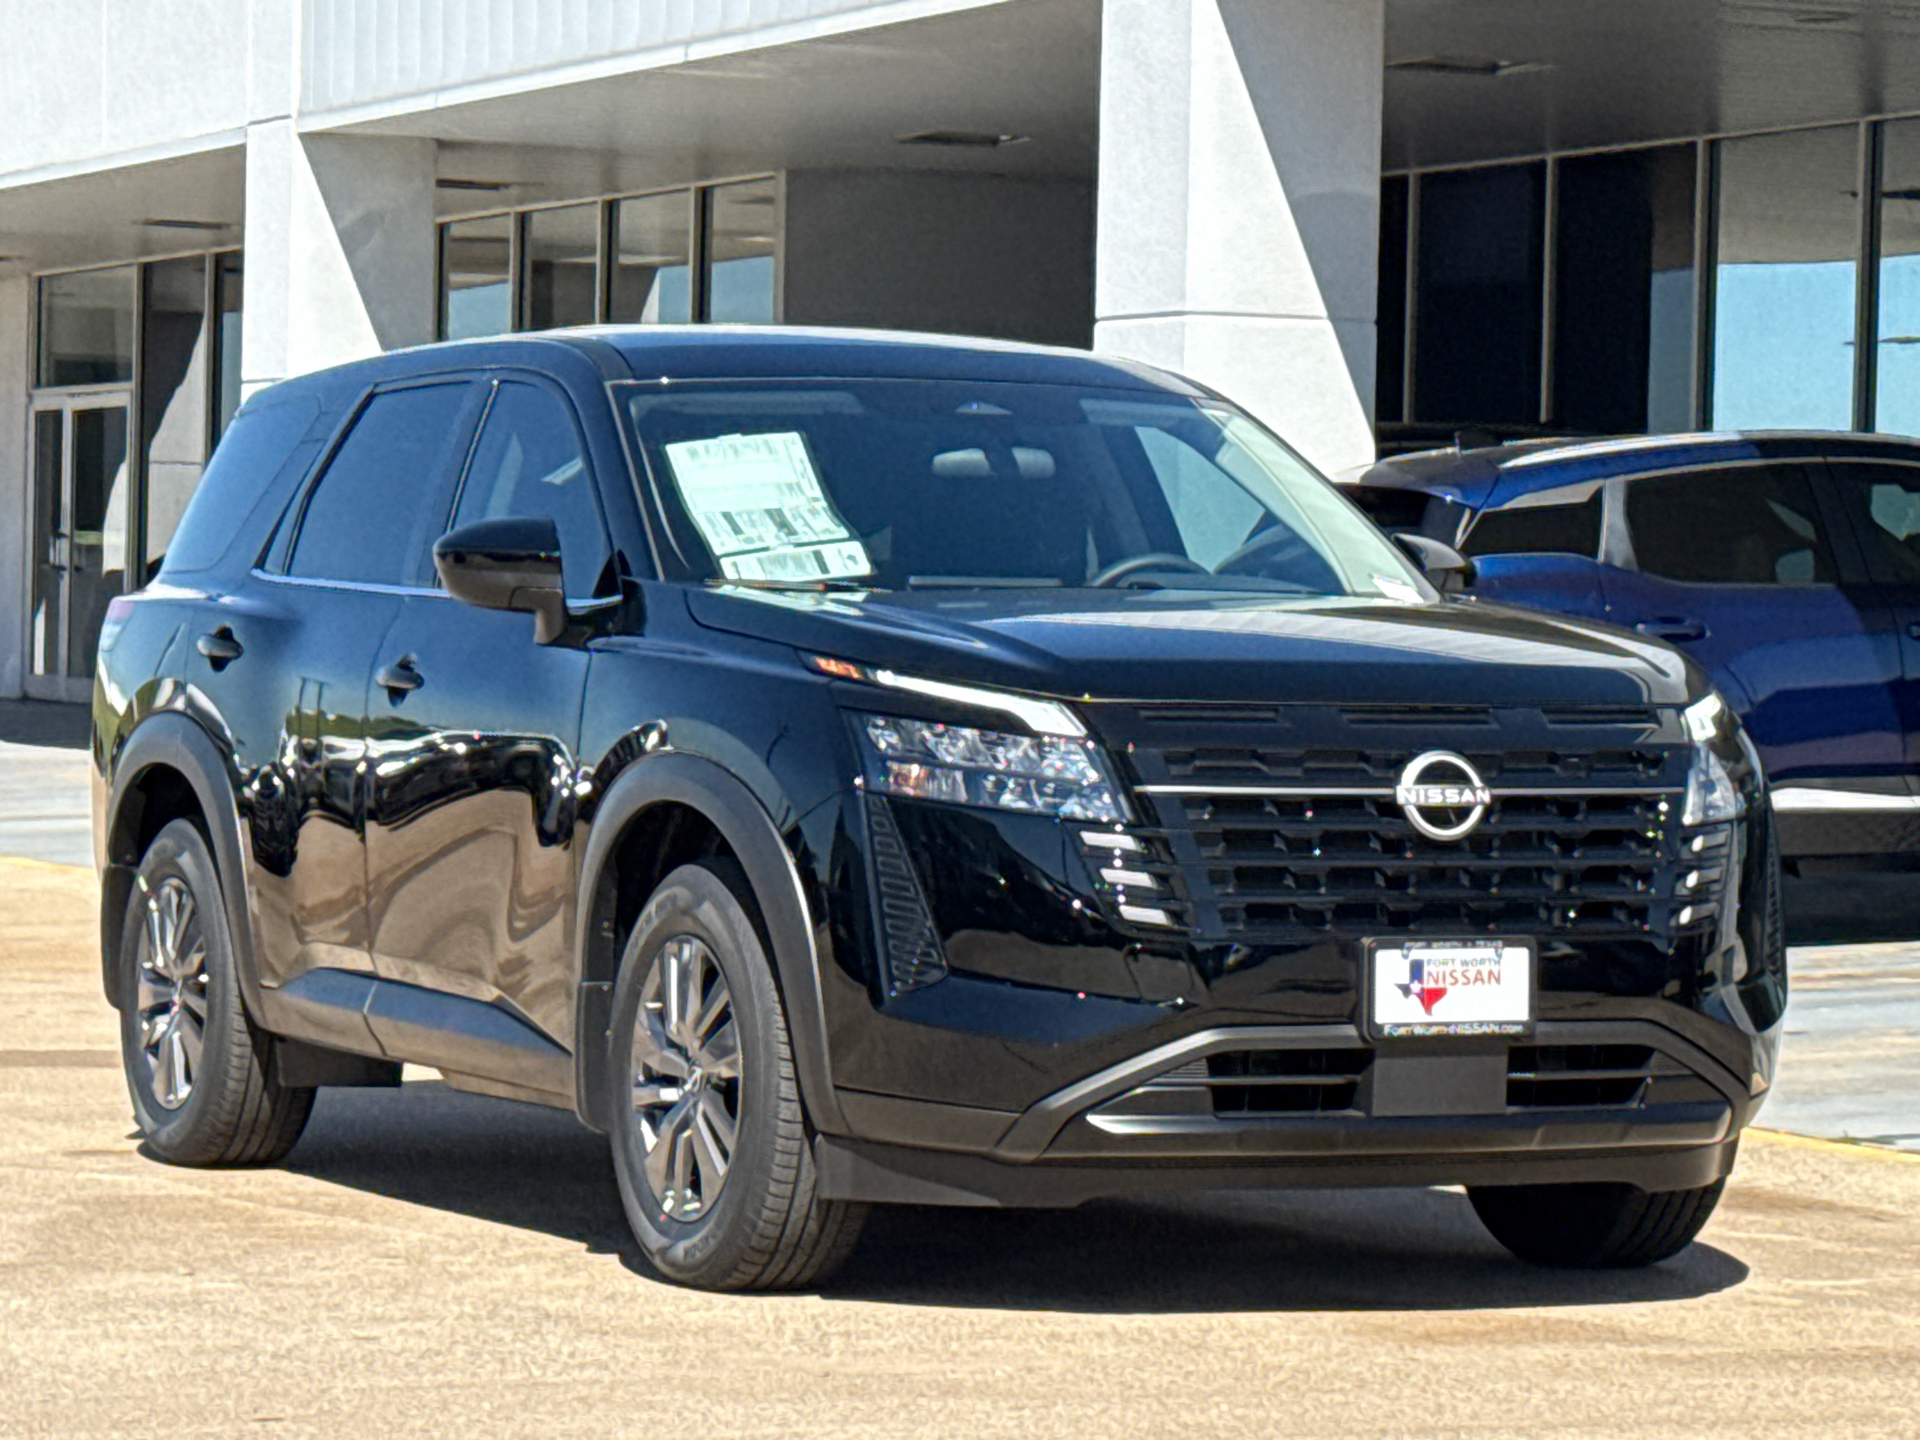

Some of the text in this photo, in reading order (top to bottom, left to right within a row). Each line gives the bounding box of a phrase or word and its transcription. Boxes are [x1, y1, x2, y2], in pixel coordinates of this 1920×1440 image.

[1396, 785, 1491, 805] NISSAN
[1426, 957, 1501, 968] FORT WORTH
[1426, 969, 1501, 986] NISSAN
